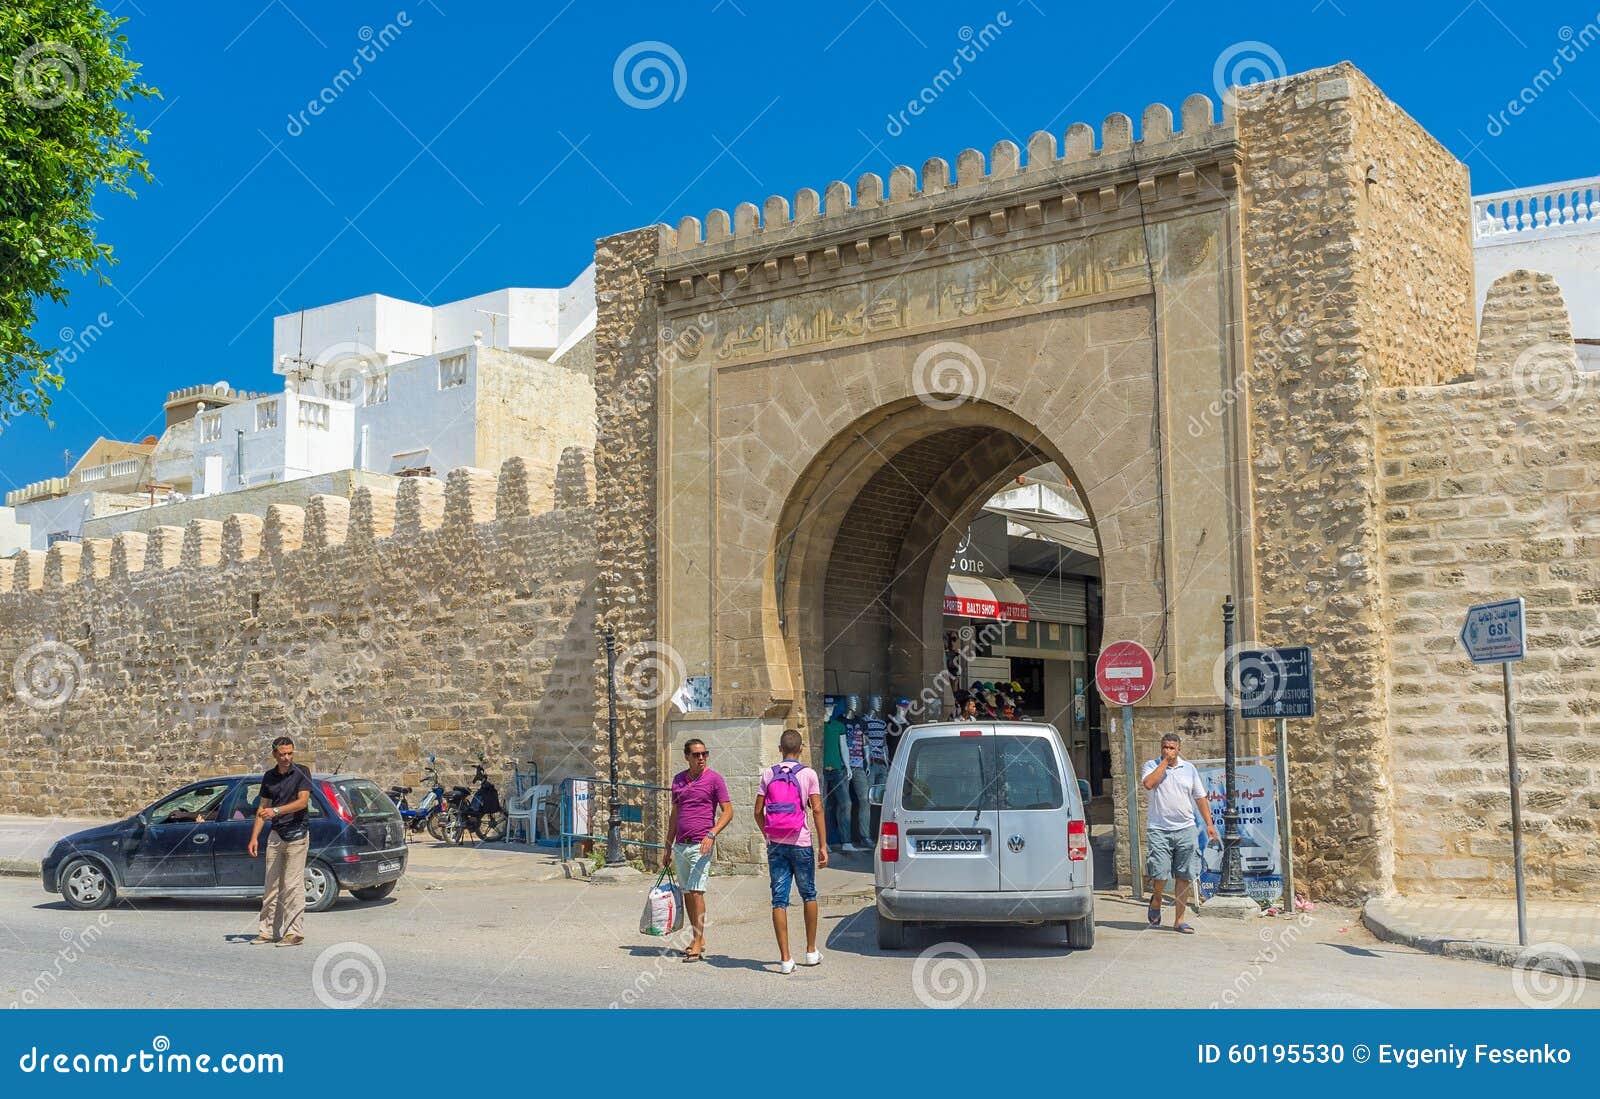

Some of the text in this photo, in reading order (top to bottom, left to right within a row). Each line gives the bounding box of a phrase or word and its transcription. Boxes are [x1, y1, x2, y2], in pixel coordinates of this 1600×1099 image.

[960, 558, 984, 573] one
[966, 602, 981, 614] BALTI
[982, 603, 995, 616] SHOP
[1488, 622, 1508, 636] GSI
[920, 841, 937, 851] 145
[953, 841, 978, 851] 9037
